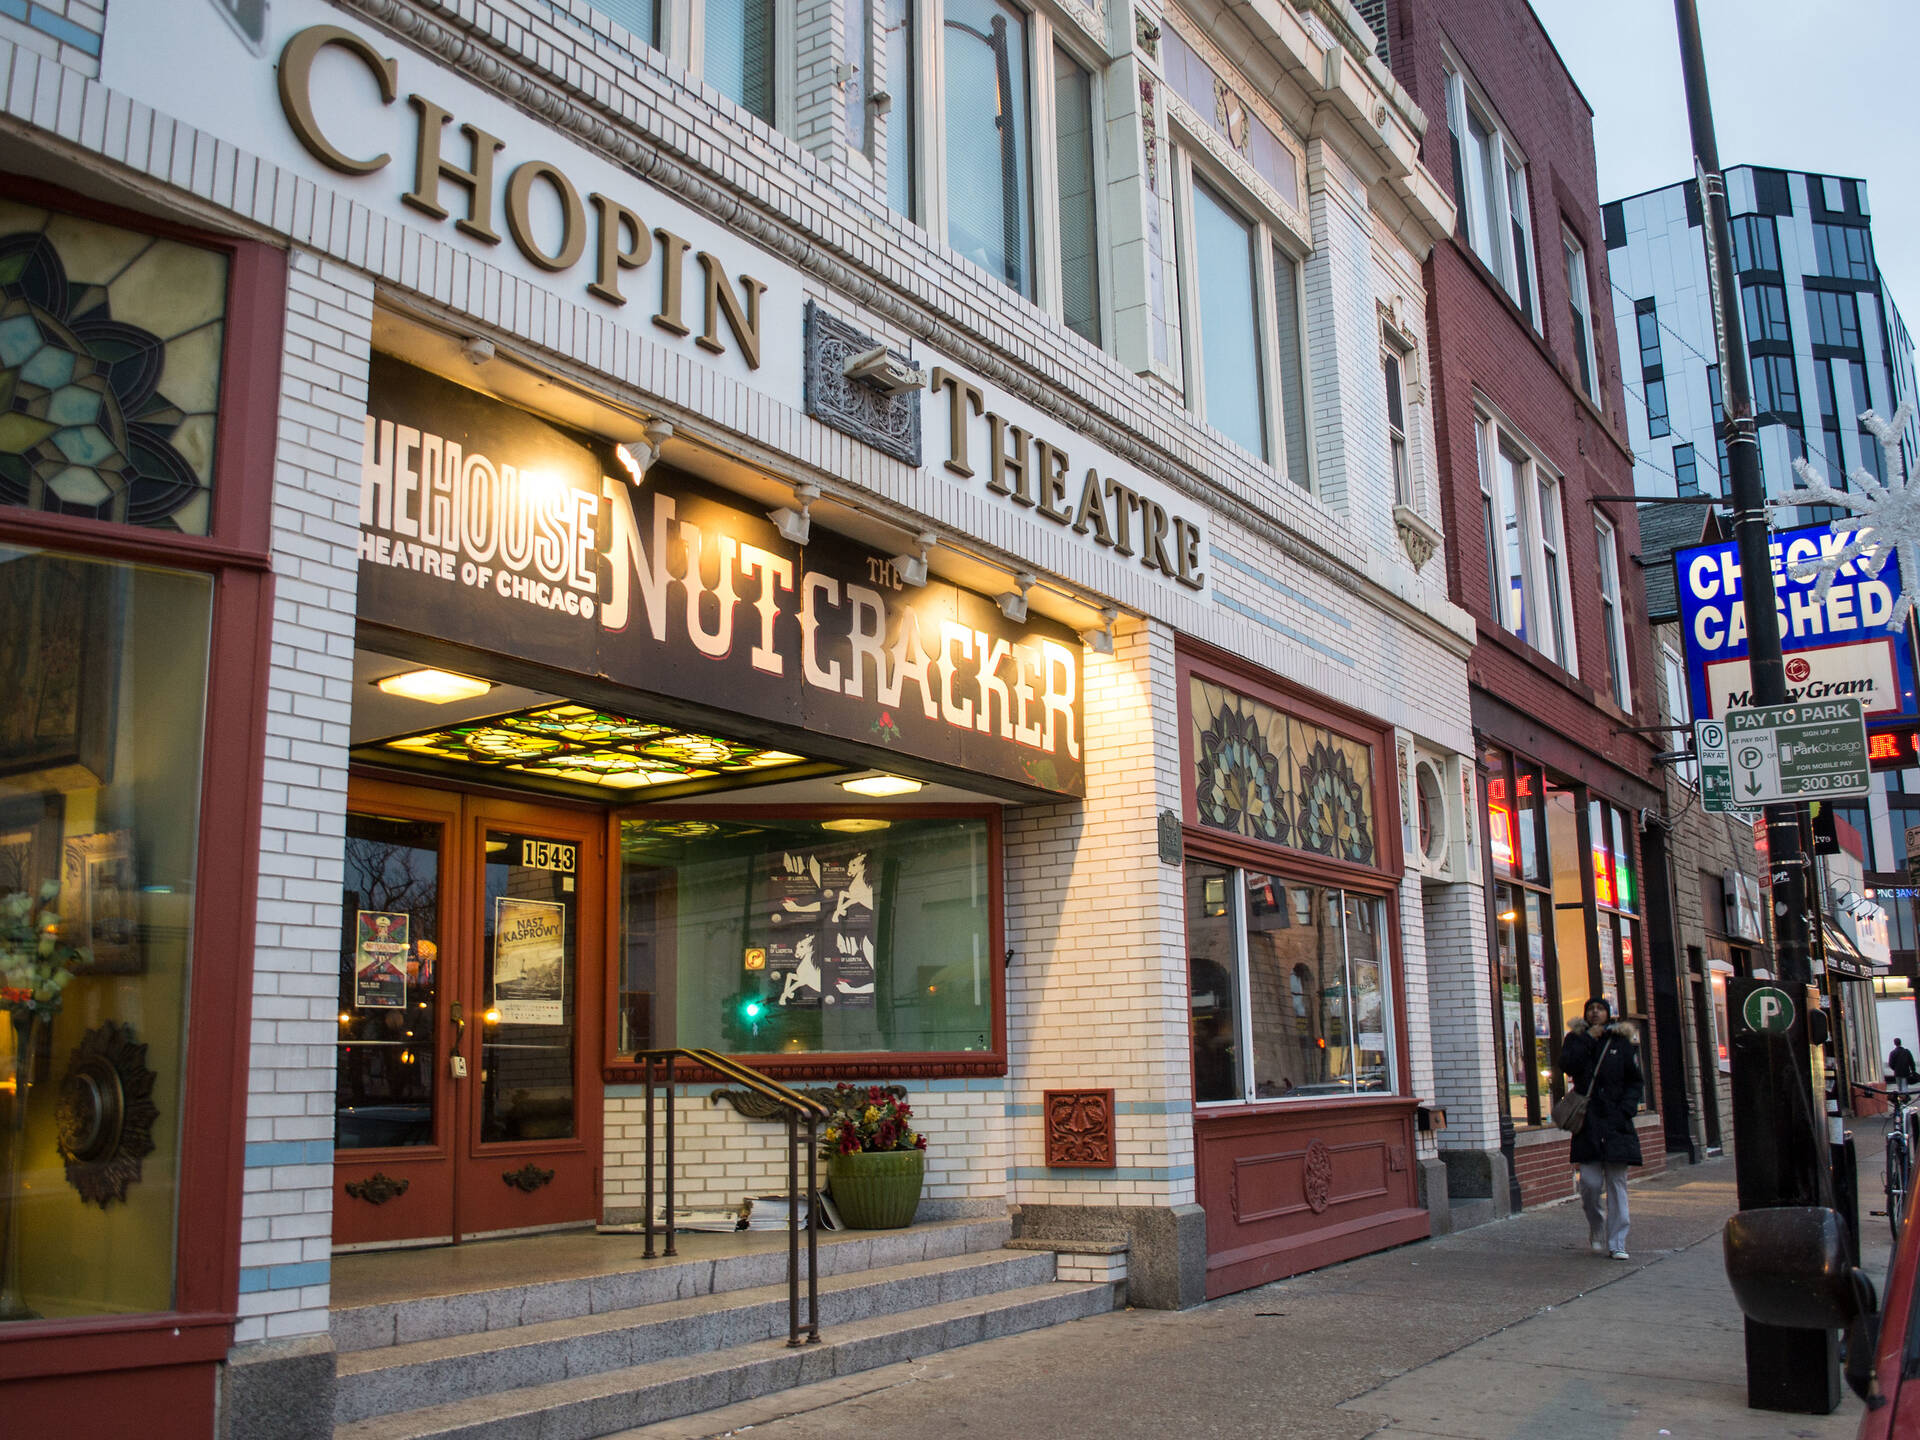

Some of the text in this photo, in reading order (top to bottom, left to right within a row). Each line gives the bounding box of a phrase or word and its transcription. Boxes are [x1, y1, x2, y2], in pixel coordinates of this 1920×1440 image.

[278, 24, 1204, 591] CHOPIN THEATRE
[420, 432, 599, 594] HOUSE
[357, 530, 595, 620] HEATRE OF CHICAGO
[866, 556, 903, 591] THE
[1735, 704, 1851, 729] PAY TO PARK
[1793, 742, 1860, 755] ParkChicago
[1801, 777, 1829, 790] 300
[1833, 774, 1860, 788] 301
[524, 841, 575, 872] 1543
[516, 917, 544, 930] NASZ
